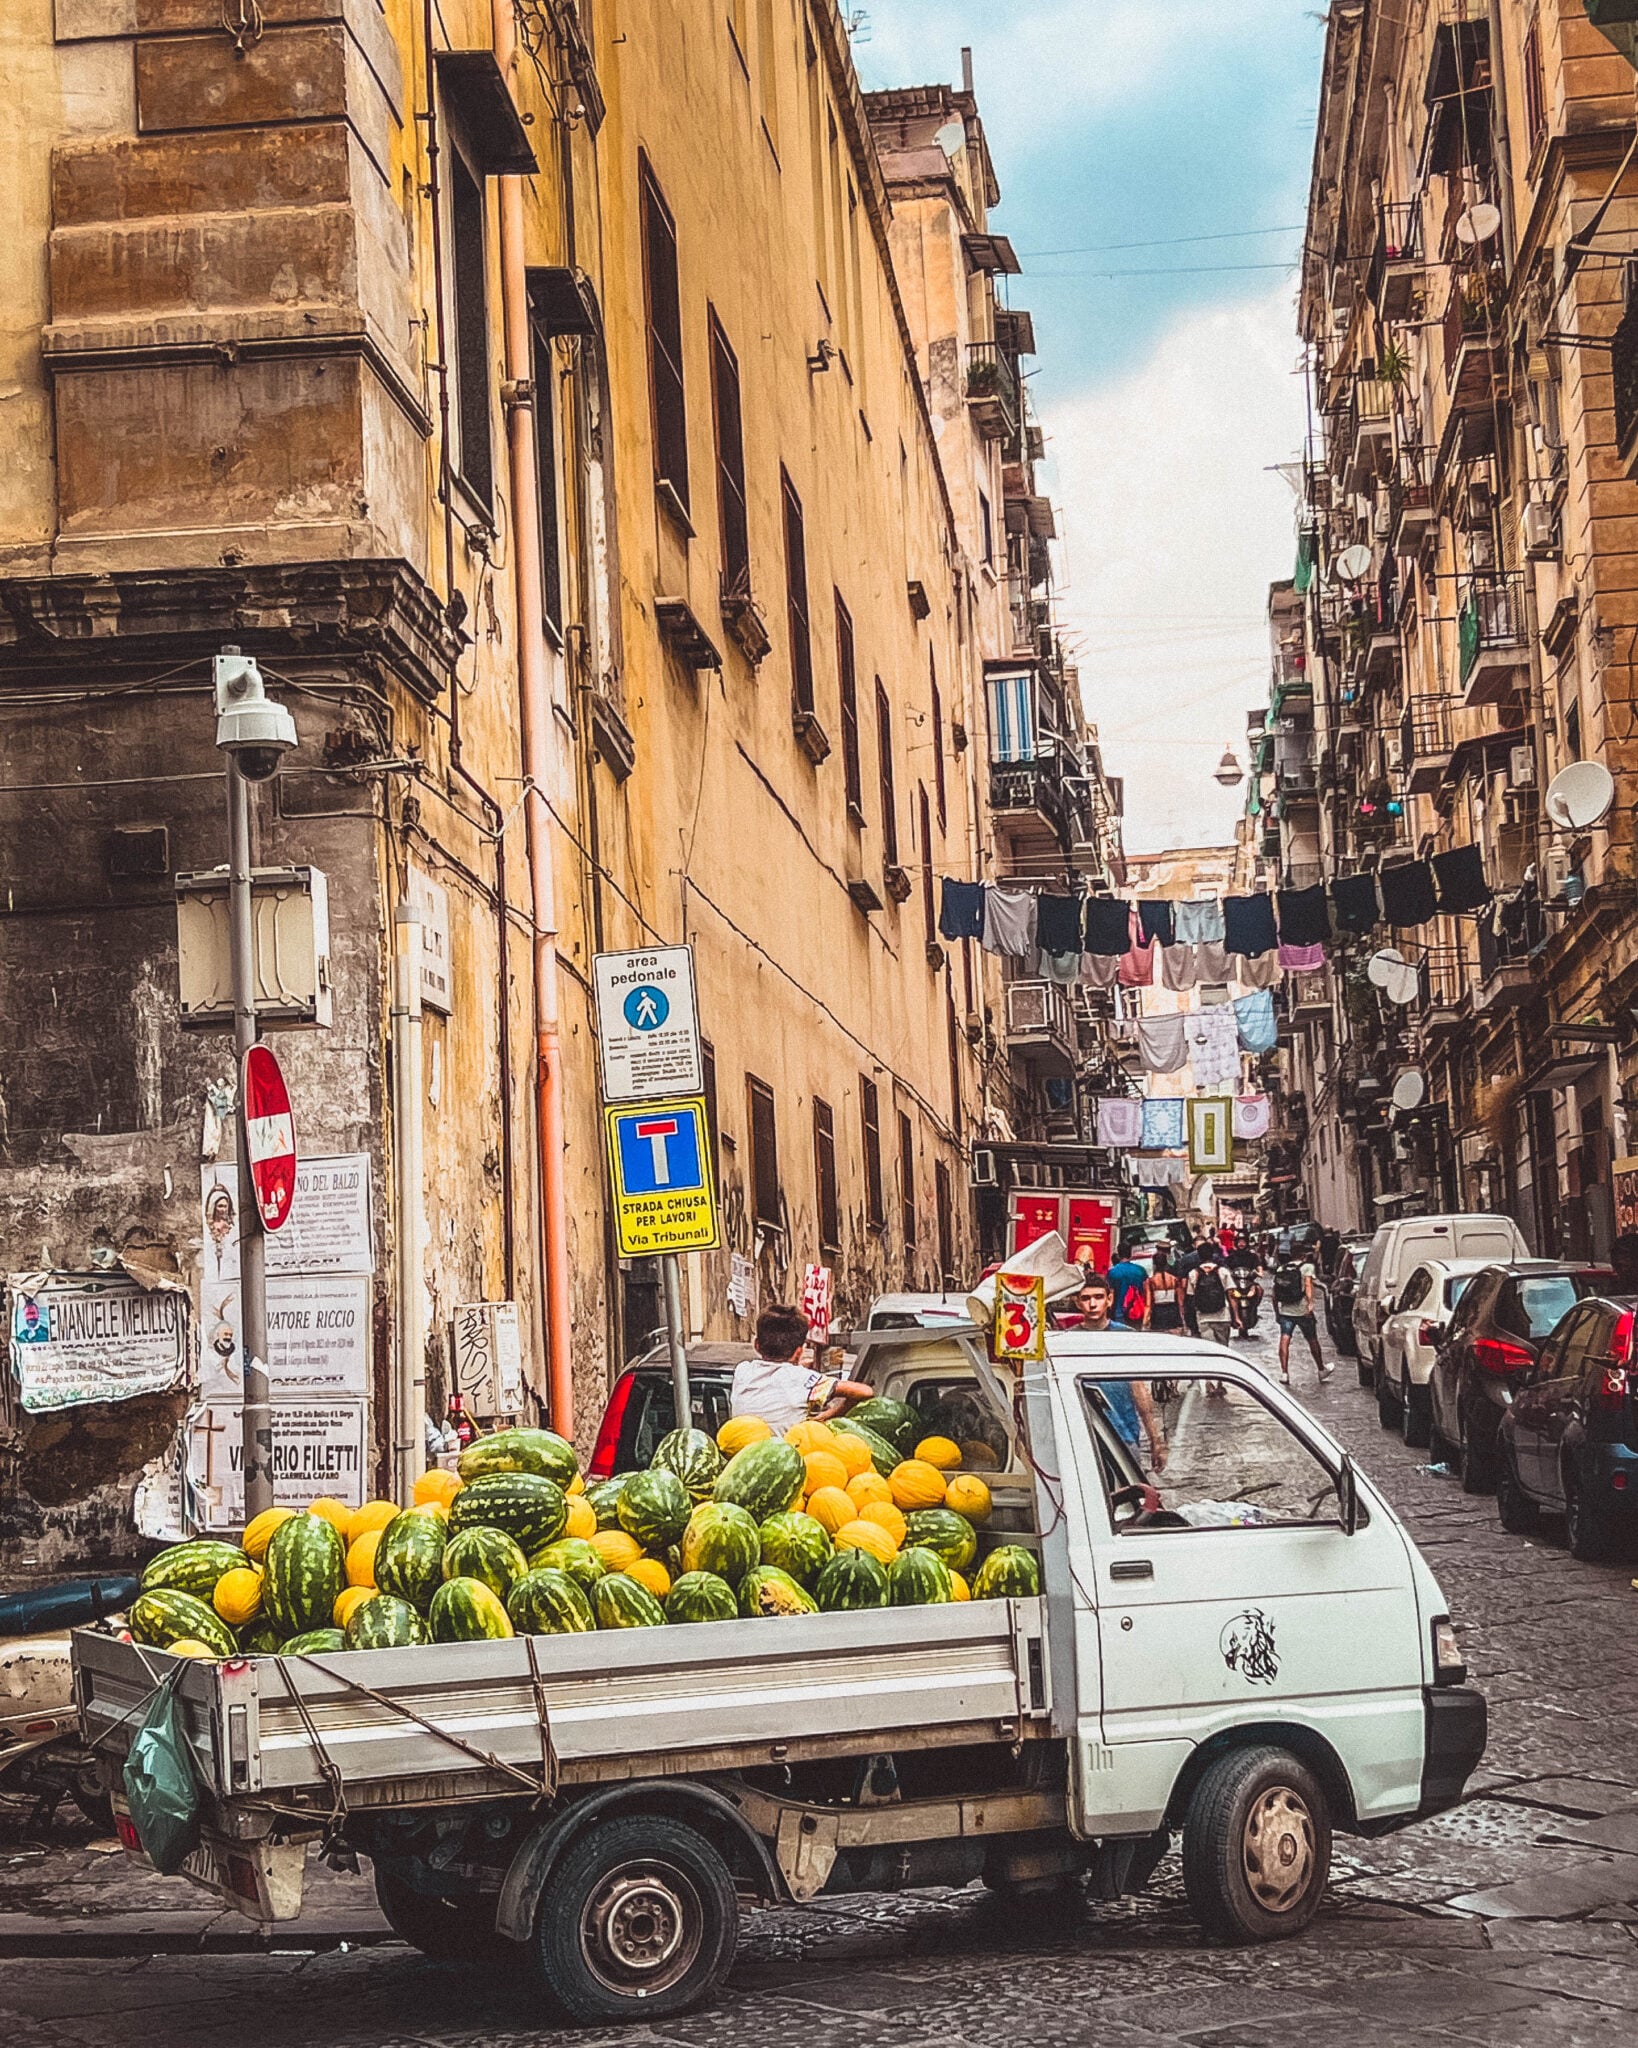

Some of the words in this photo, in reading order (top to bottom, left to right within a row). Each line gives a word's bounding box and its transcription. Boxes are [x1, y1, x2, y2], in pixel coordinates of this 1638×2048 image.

[626, 956, 658, 968] area
[611, 967, 677, 988] pedonale
[312, 1174, 329, 1192] DEL
[332, 1171, 360, 1190] BALZO
[622, 1200, 664, 1215] STRADA
[667, 1196, 708, 1210] CHIUSA
[636, 1215, 656, 1227] PER
[660, 1211, 697, 1225] LAVORI
[627, 1234, 649, 1246] Via
[652, 1227, 709, 1243] Tribunali
[48, 1299, 120, 1342] EMANUELE
[121, 1294, 175, 1338] MELILLO
[266, 1310, 311, 1330] VATORE
[316, 1309, 355, 1329] RICCIO
[1003, 1302, 1031, 1348] 3
[229, 1444, 299, 1472] VIRIO
[303, 1444, 358, 1472] FILETTI
[279, 1471, 312, 1480] CARMELA
